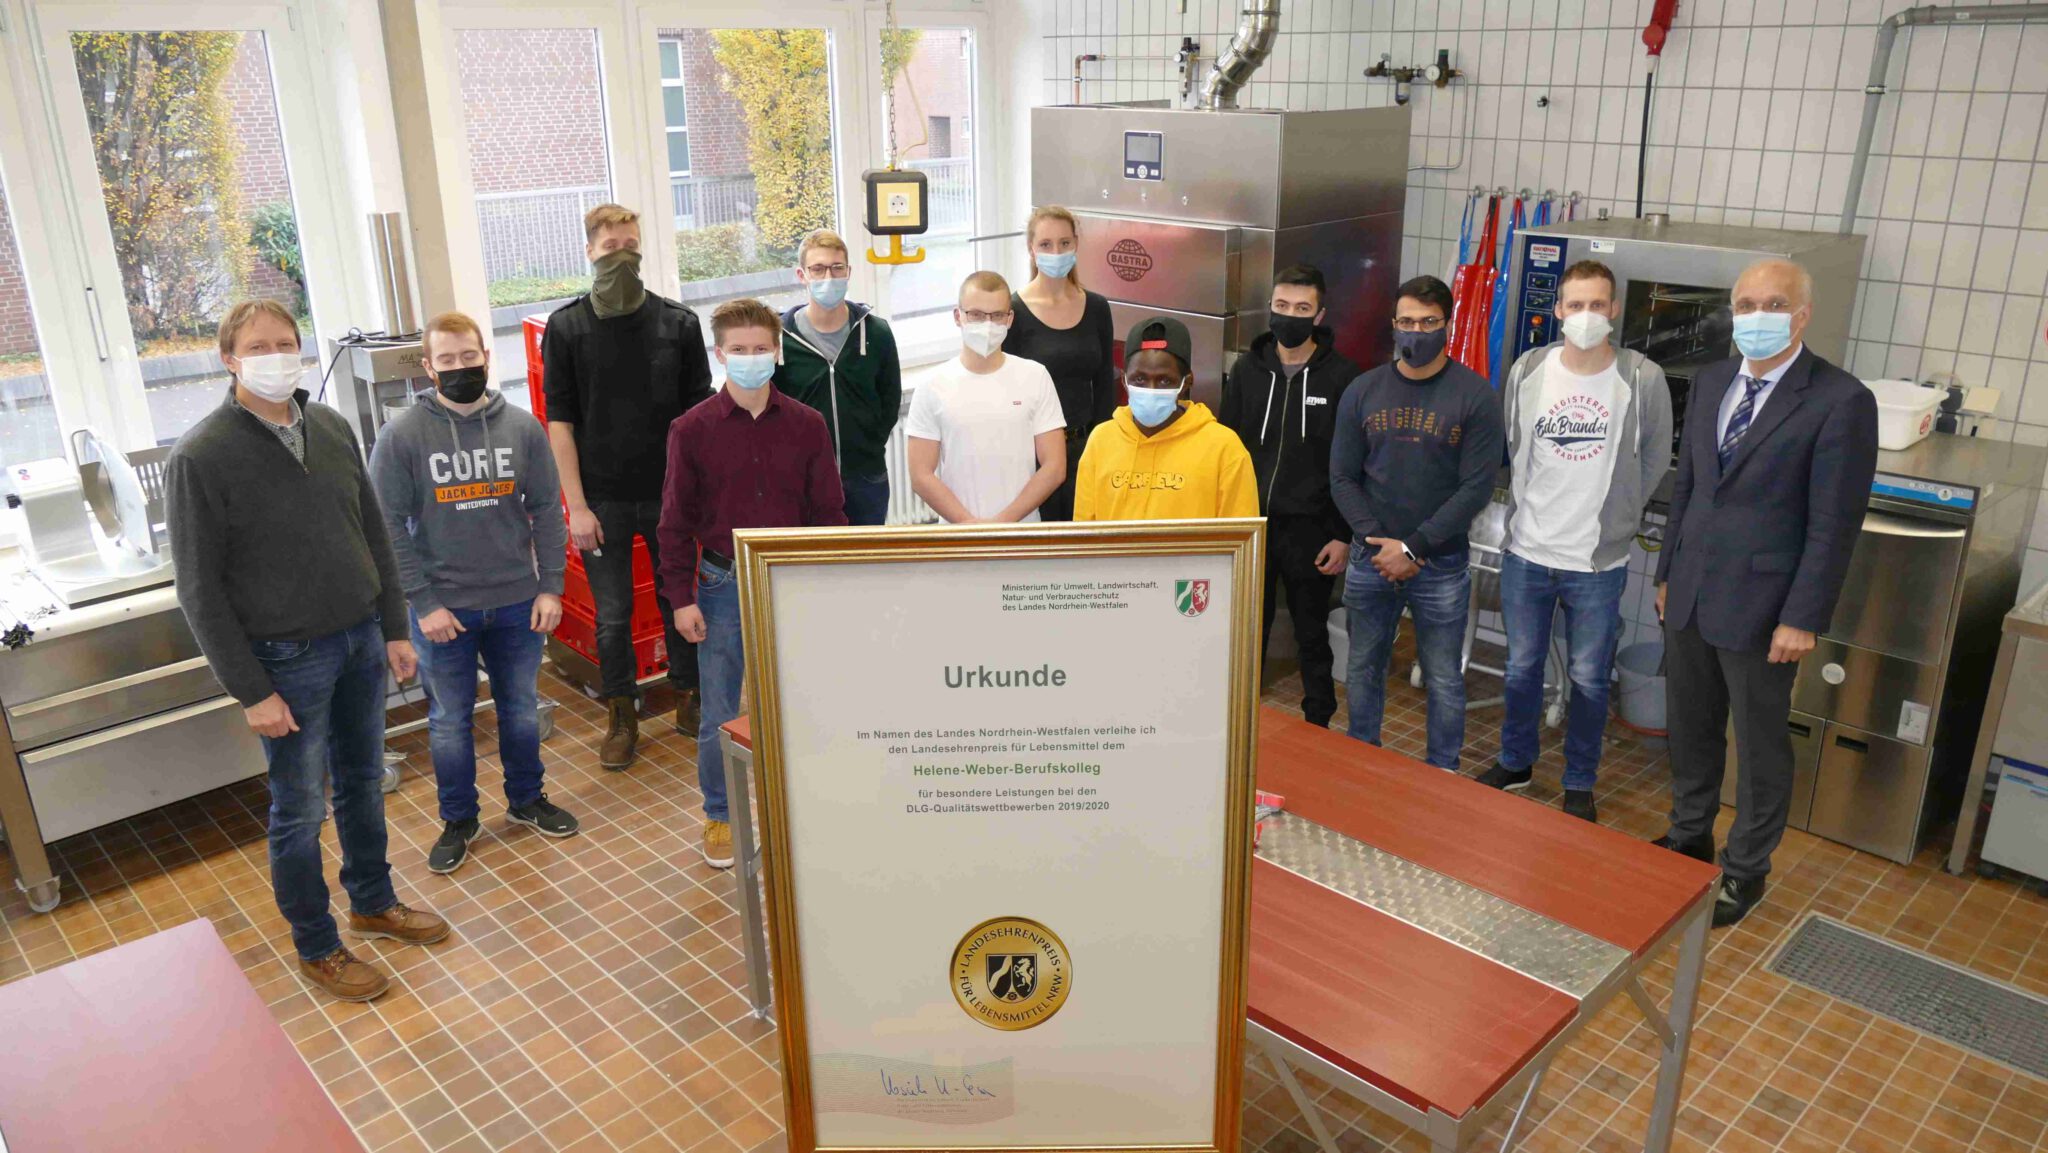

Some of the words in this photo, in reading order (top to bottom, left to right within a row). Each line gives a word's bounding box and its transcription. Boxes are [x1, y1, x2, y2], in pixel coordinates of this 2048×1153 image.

[1110, 254, 1148, 267] BASTRA
[1548, 395, 1609, 418] REGISTERED
[1551, 444, 1604, 461] TRADEMARK
[429, 447, 515, 484] CORE
[440, 488, 467, 500] JACK
[1002, 583, 1049, 592] Ministerium
[1050, 583, 1062, 591] für
[1002, 594, 1027, 602] Natur-
[1029, 593, 1044, 601] und
[1046, 592, 1119, 601] Verbraucherschutz
[1002, 603, 1017, 611] des
[1018, 603, 1047, 611] Landes
[1048, 602, 1128, 610] Nordrhein-Westfalen
[944, 664, 1067, 688] Urkunde
[857, 730, 870, 739] Im
[873, 730, 911, 739] Namen
[913, 729, 933, 738] des
[936, 728, 976, 738] Landes
[979, 727, 1090, 737] Nordrhein-Westfalen
[1093, 726, 1137, 735] verleihe
[1140, 725, 1156, 735] ich
[888, 745, 908, 754] den
[911, 743, 1008, 754] Landesehrenpreis
[1011, 742, 1026, 751] für
[1029, 742, 1099, 751] Lebensmittel
[1102, 742, 1125, 750] dem
[913, 762, 1101, 776] Helene-Weber-Berufskolleg
[918, 789, 933, 798] für
[936, 788, 992, 798] besondere
[995, 787, 1055, 798] Leistungen
[1058, 787, 1074, 796] bei
[1077, 787, 1097, 796] den
[906, 802, 1055, 813] DLG-Qualitätswettbewerben
[1058, 801, 1110, 811] 2019/2020
[960, 927, 1061, 967] LANDESEHRENPREIS
[960, 975, 974, 998] FÜR
[969, 997, 1050, 1022] LEBENSMITTEL
[1046, 974, 1062, 1002] NRW
